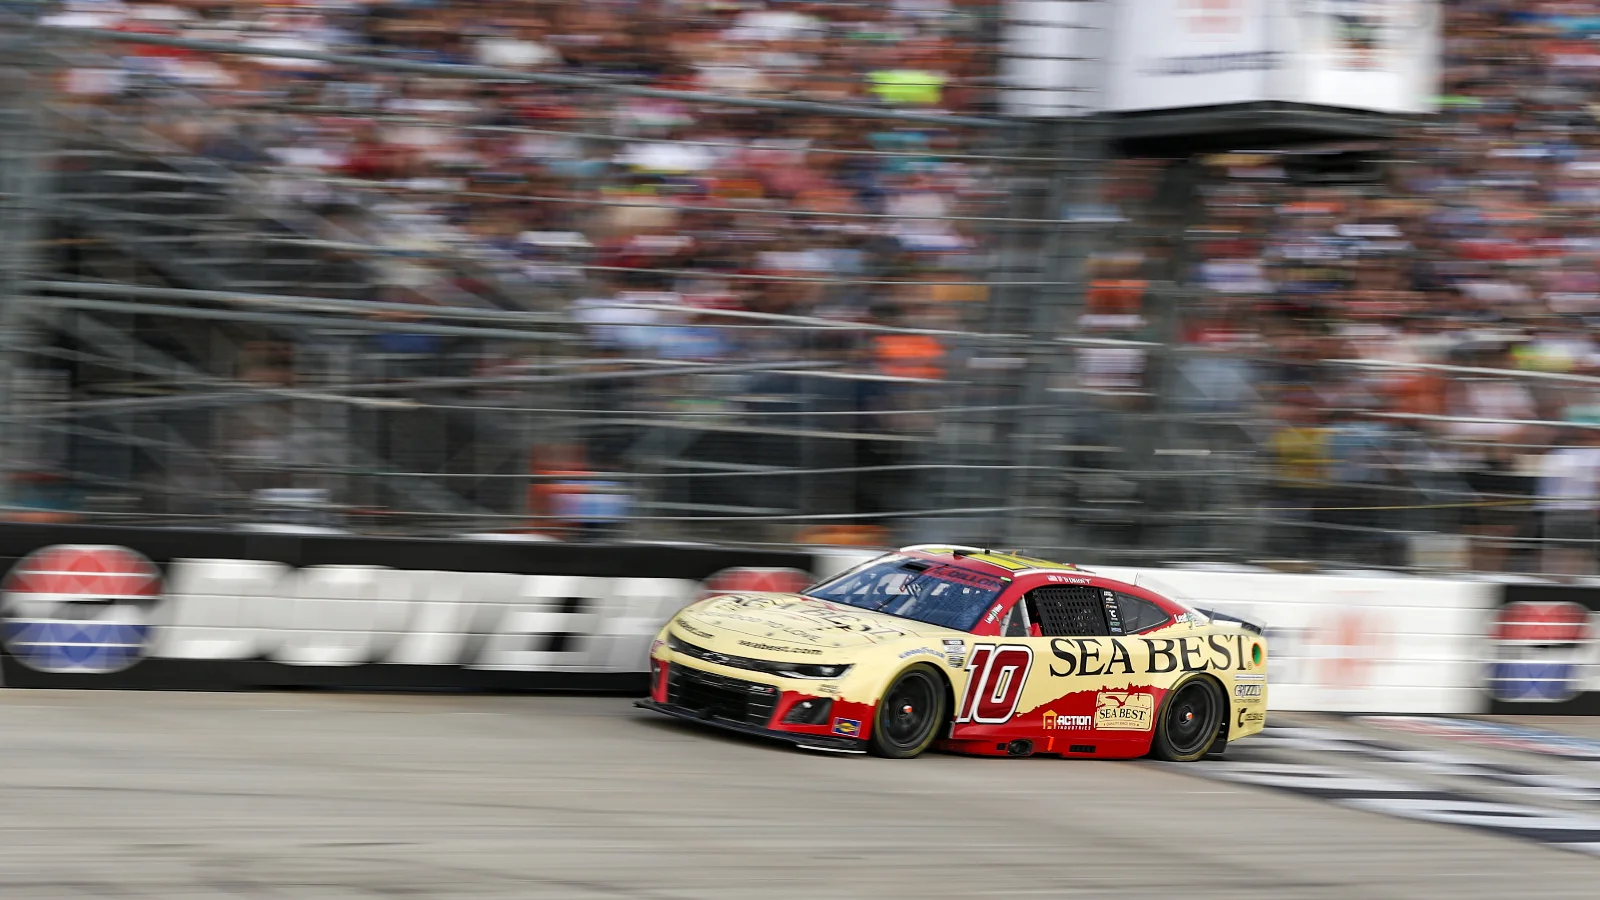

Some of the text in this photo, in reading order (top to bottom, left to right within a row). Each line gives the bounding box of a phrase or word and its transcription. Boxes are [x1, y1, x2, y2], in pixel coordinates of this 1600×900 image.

[1050, 637, 1135, 677] SEA
[1137, 634, 1250, 674] BEST
[955, 643, 1034, 724] 10
[1057, 715, 1092, 726] ACTION
[1099, 708, 1147, 721] SEA BEST
